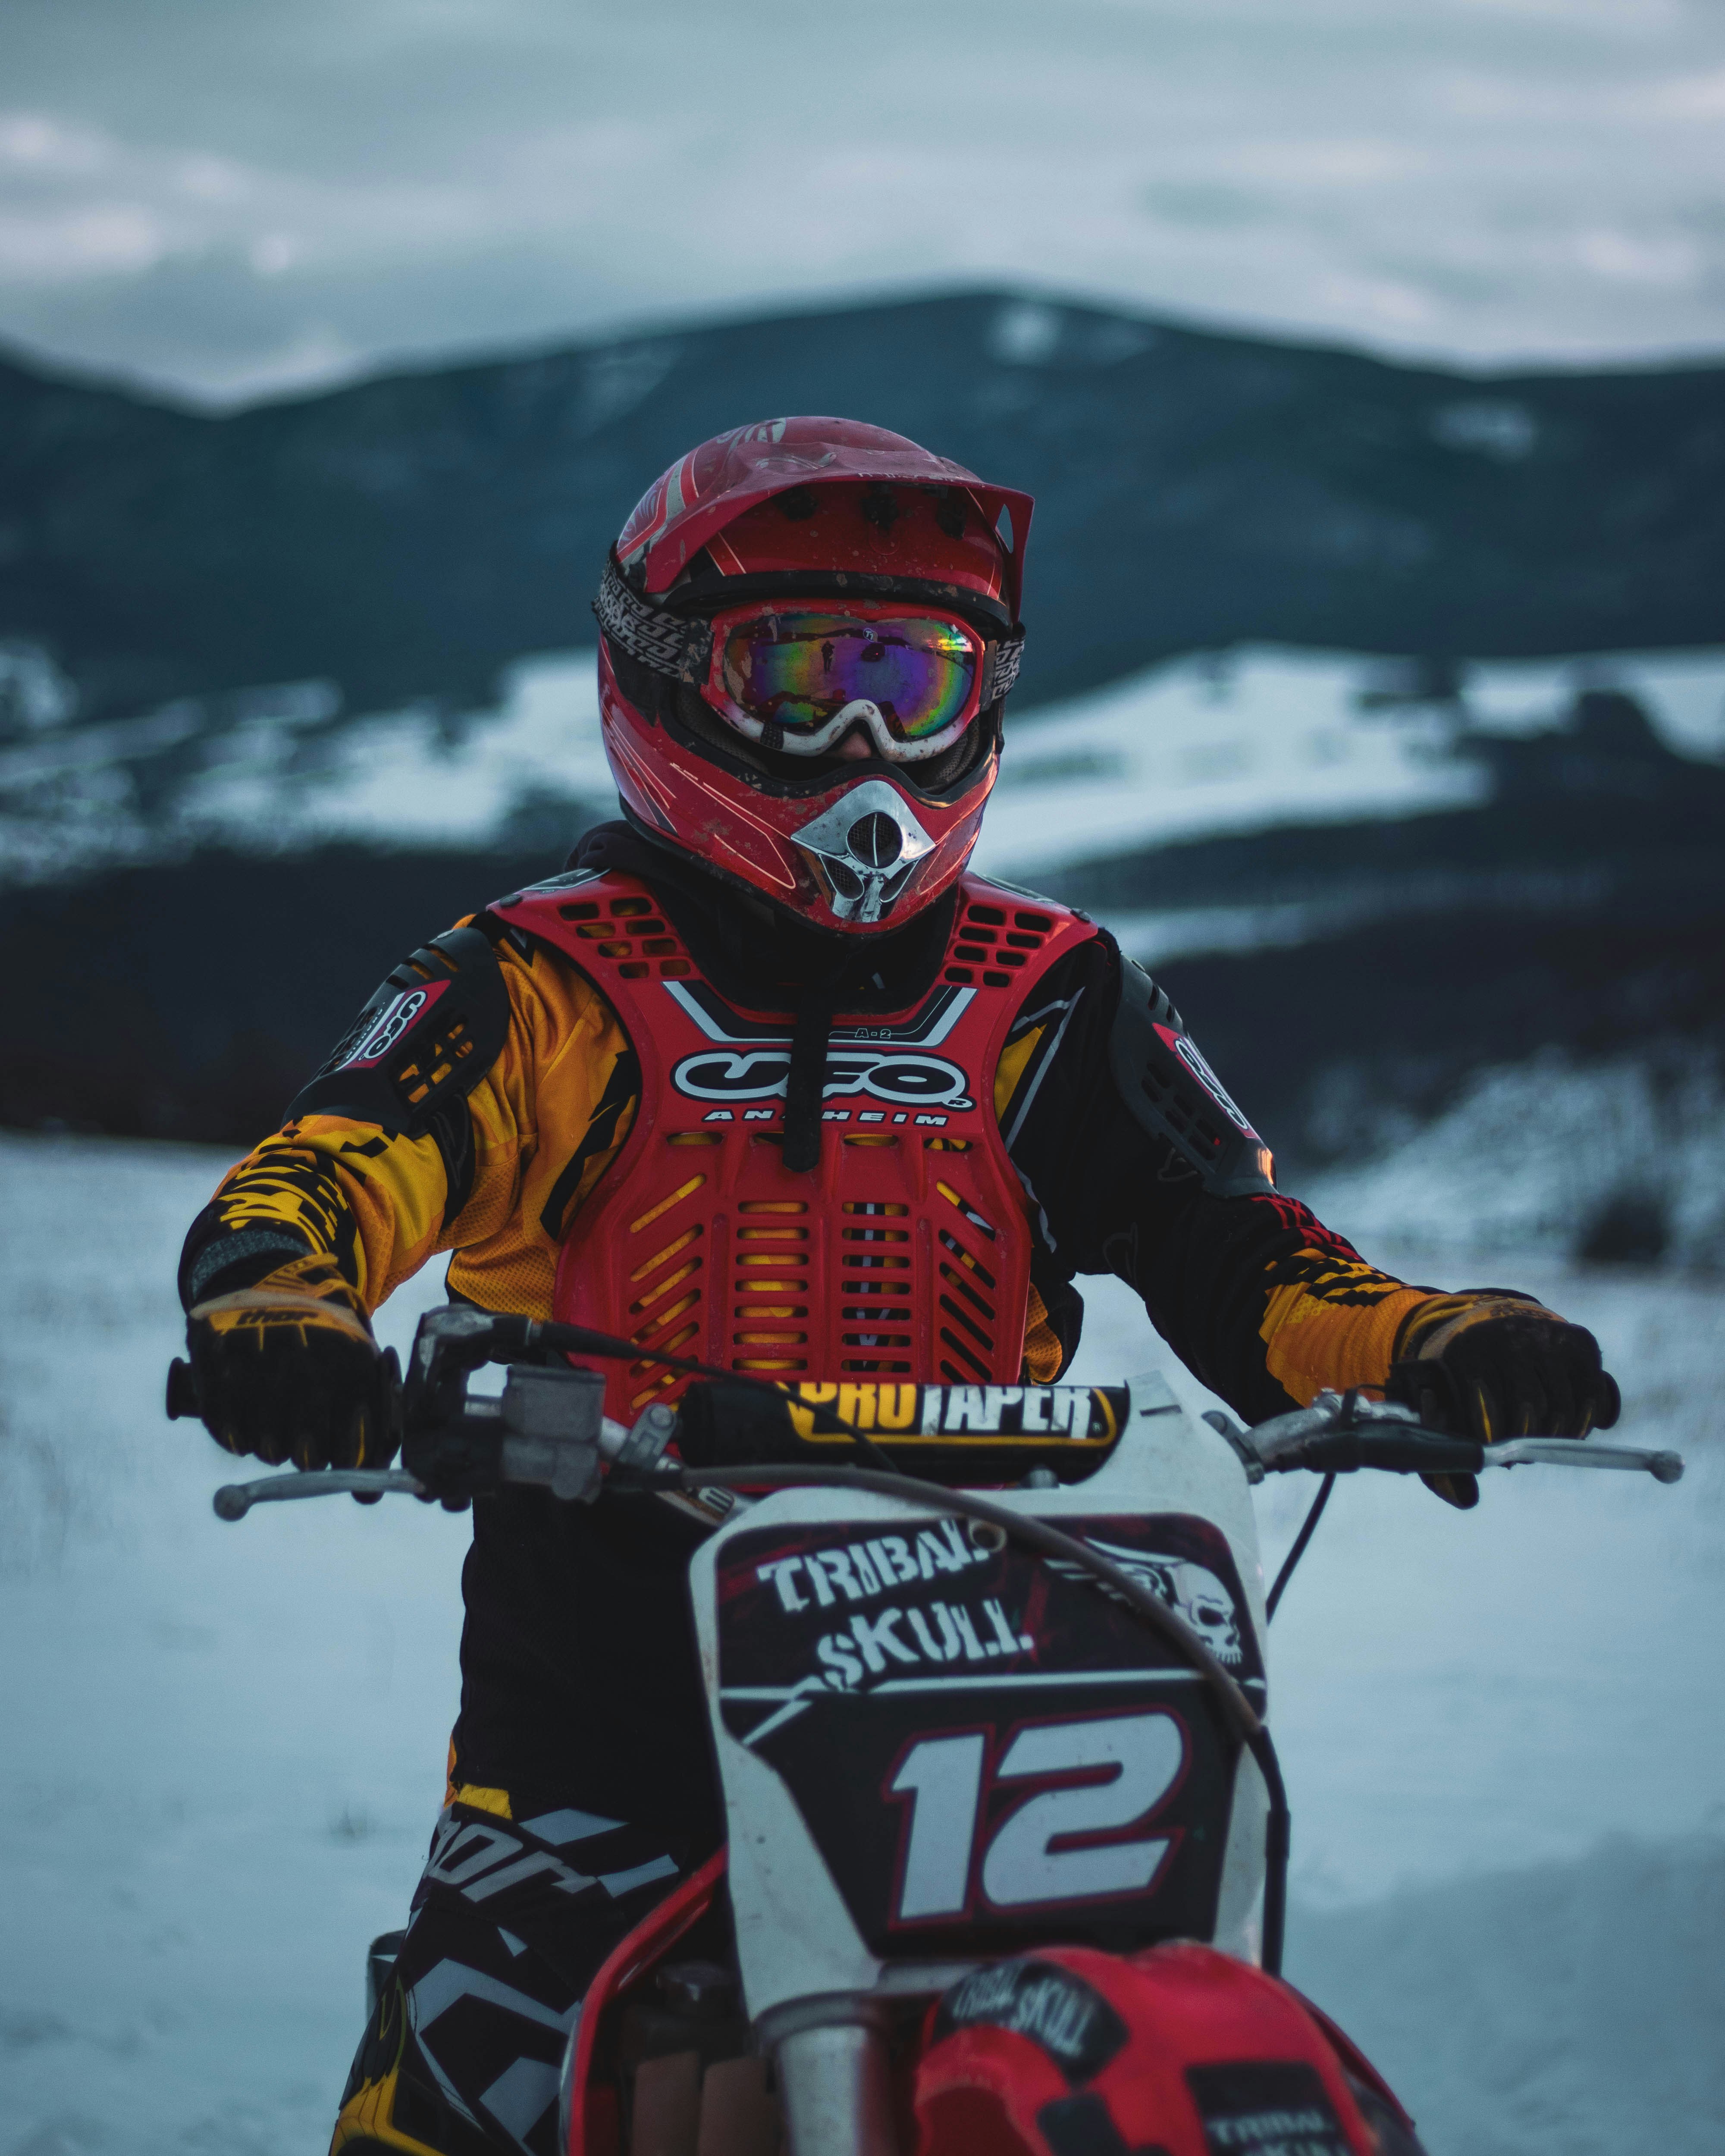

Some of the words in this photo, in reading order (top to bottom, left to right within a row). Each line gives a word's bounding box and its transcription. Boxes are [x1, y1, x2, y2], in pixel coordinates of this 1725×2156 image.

[366, 991, 426, 1059] UFO
[674, 1052, 966, 1103] UFO
[704, 1110, 948, 1126] ANHEIM
[756, 1519, 990, 1613] TRIBAL
[817, 1598, 1034, 1692] SKULL
[888, 1709, 1185, 1924] 12
